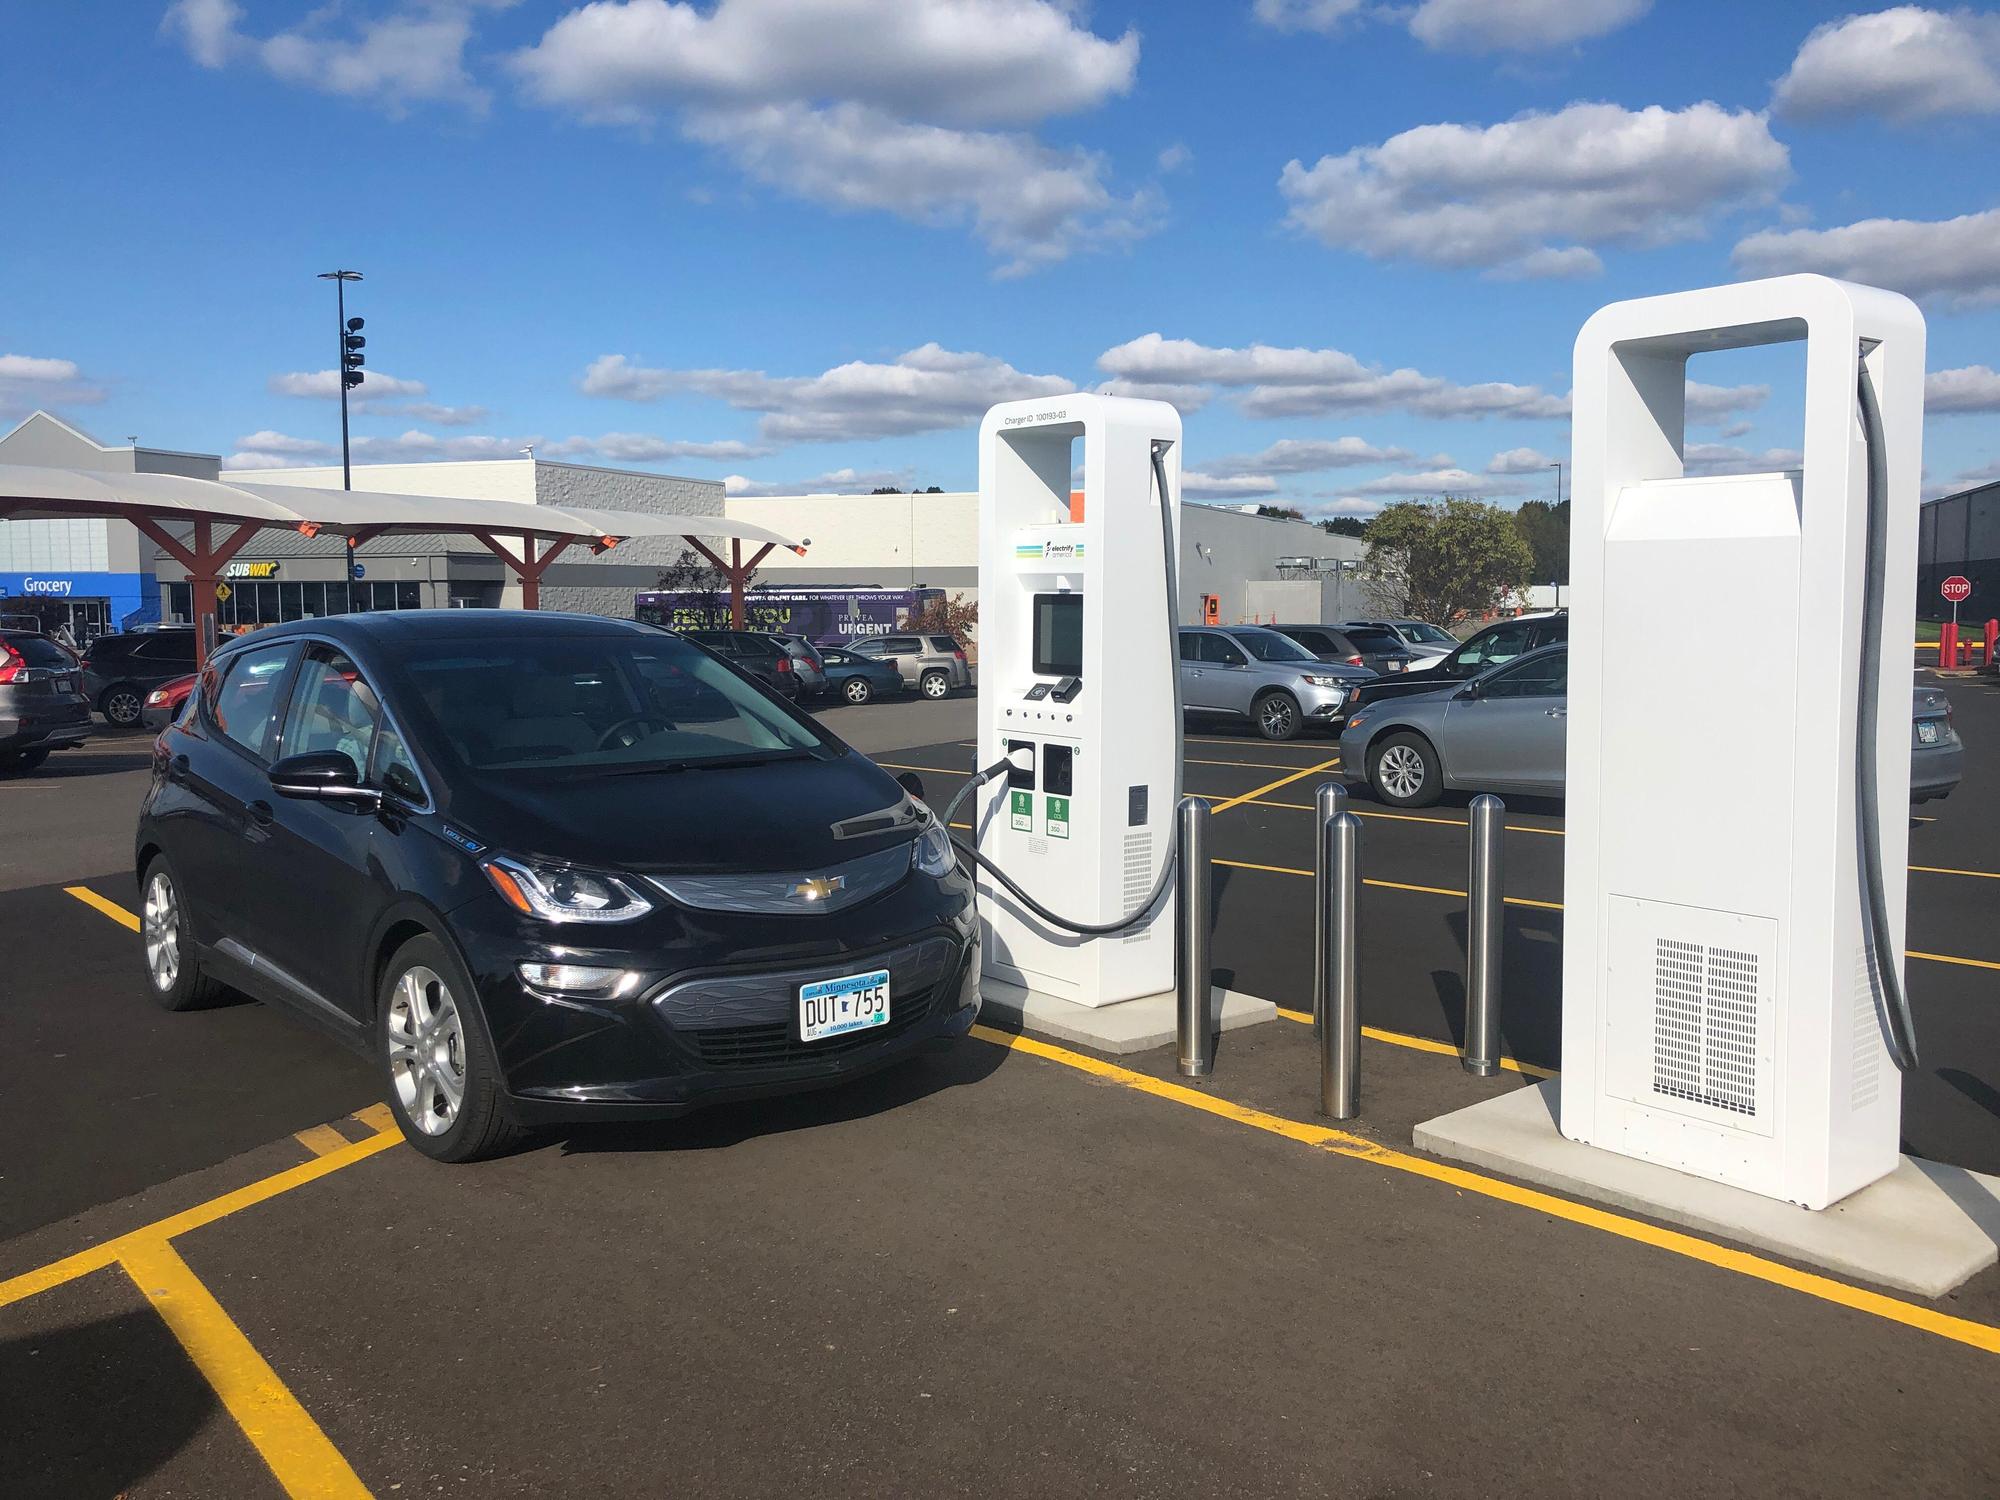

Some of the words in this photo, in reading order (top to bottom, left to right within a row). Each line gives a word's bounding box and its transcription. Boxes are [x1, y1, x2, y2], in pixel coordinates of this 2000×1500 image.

[1004, 417, 1026, 425] Charger
[1027, 414, 1033, 422] ID
[1052, 544, 1074, 552] electrify
[227, 562, 277, 577] SUBWAY
[24, 577, 72, 596] Grocery
[1944, 584, 1968, 594] STOP
[753, 608, 791, 624] YOU
[825, 979, 866, 993] Minnesota
[806, 995, 838, 1028] DUT
[853, 986, 884, 1018] 755
[848, 1020, 863, 1028] lakes
